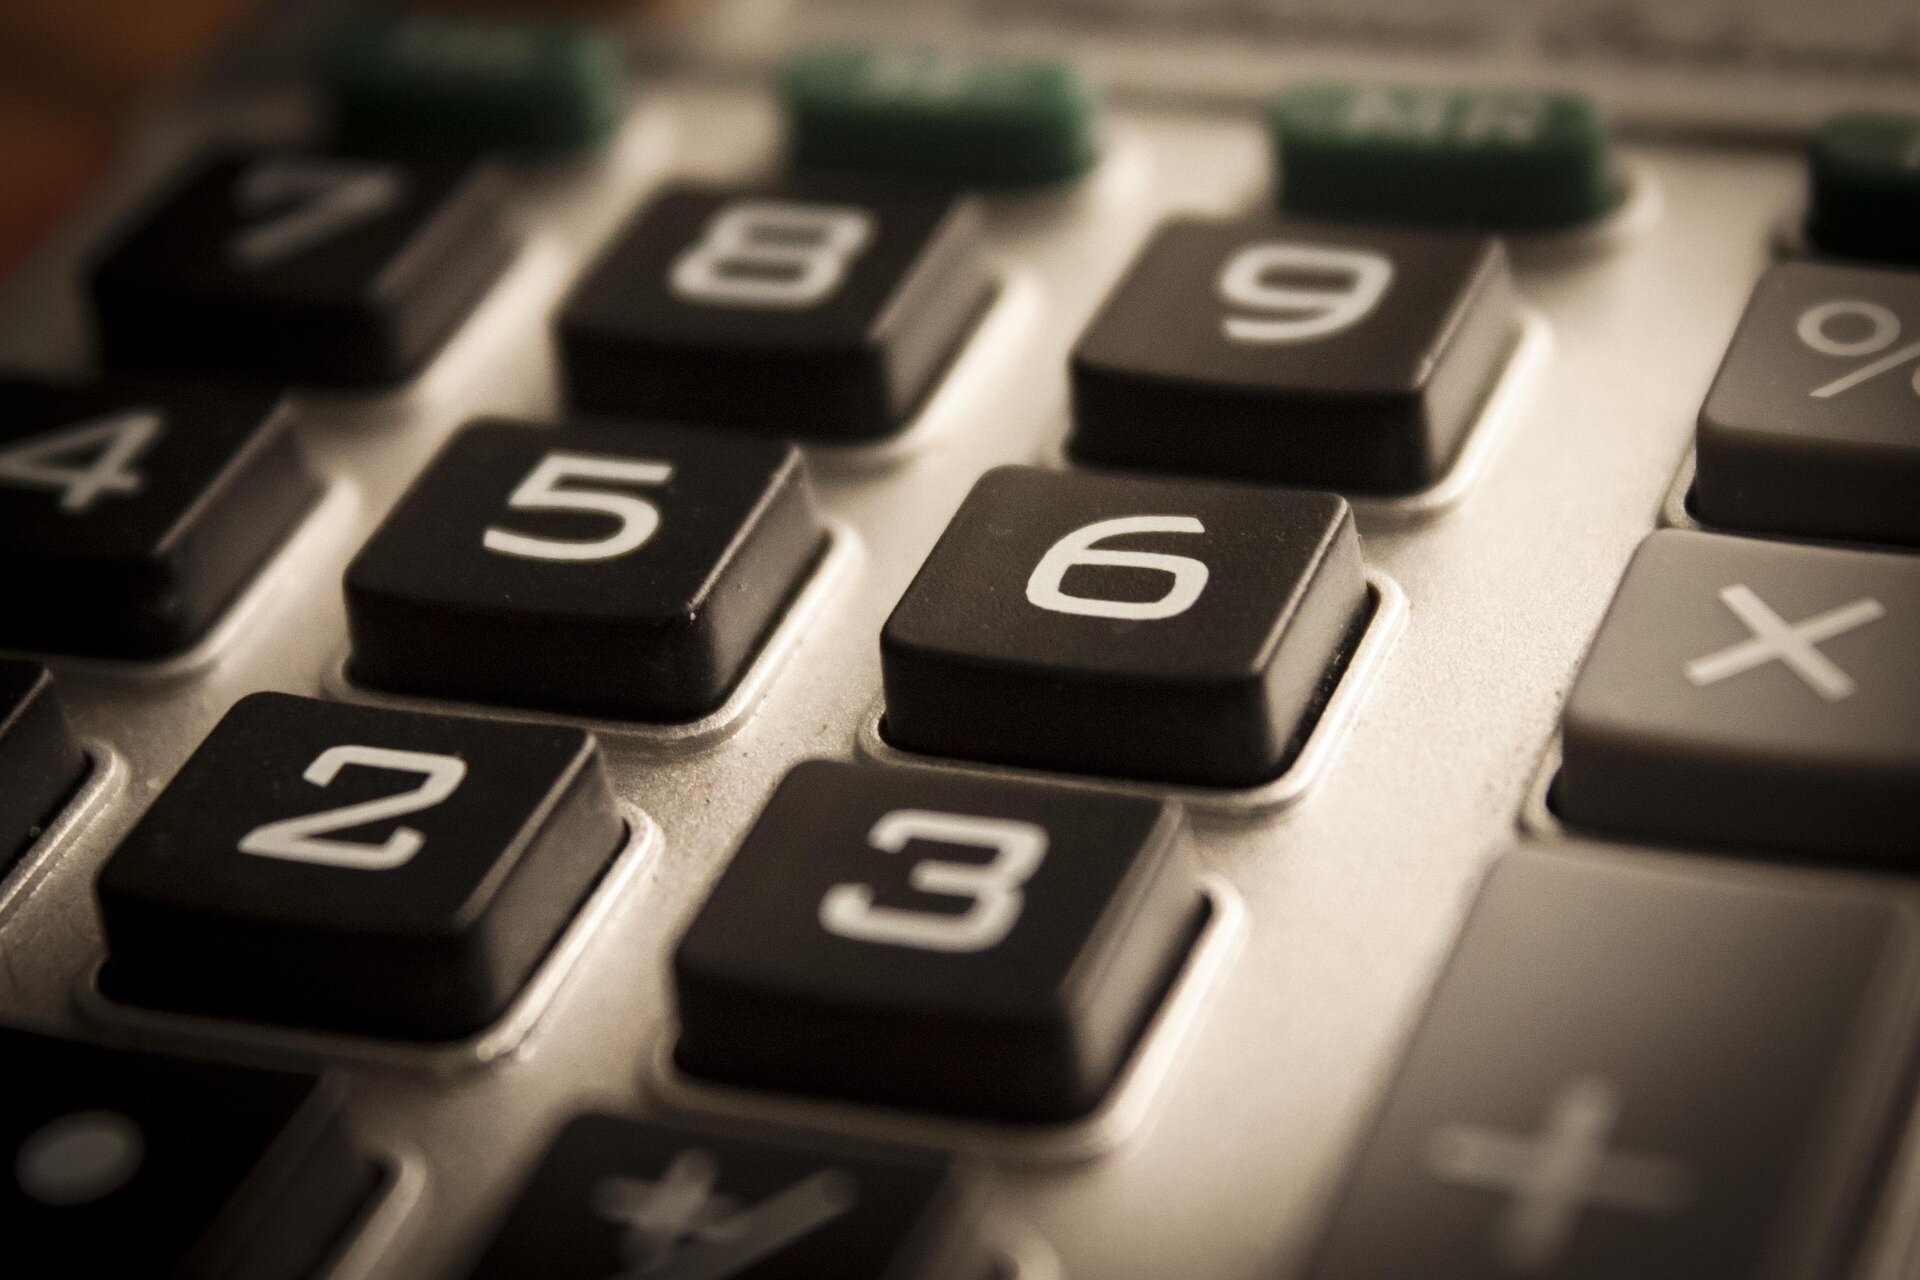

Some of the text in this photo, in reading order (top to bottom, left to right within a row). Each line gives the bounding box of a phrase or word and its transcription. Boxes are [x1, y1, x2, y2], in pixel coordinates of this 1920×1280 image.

[668, 201, 873, 308] 8
[1216, 242, 1395, 344] 9
[0, 411, 162, 512] 4
[482, 452, 673, 562] 5
[1025, 514, 1210, 621] 6
[238, 743, 467, 870] 2
[818, 808, 1049, 952] 3
